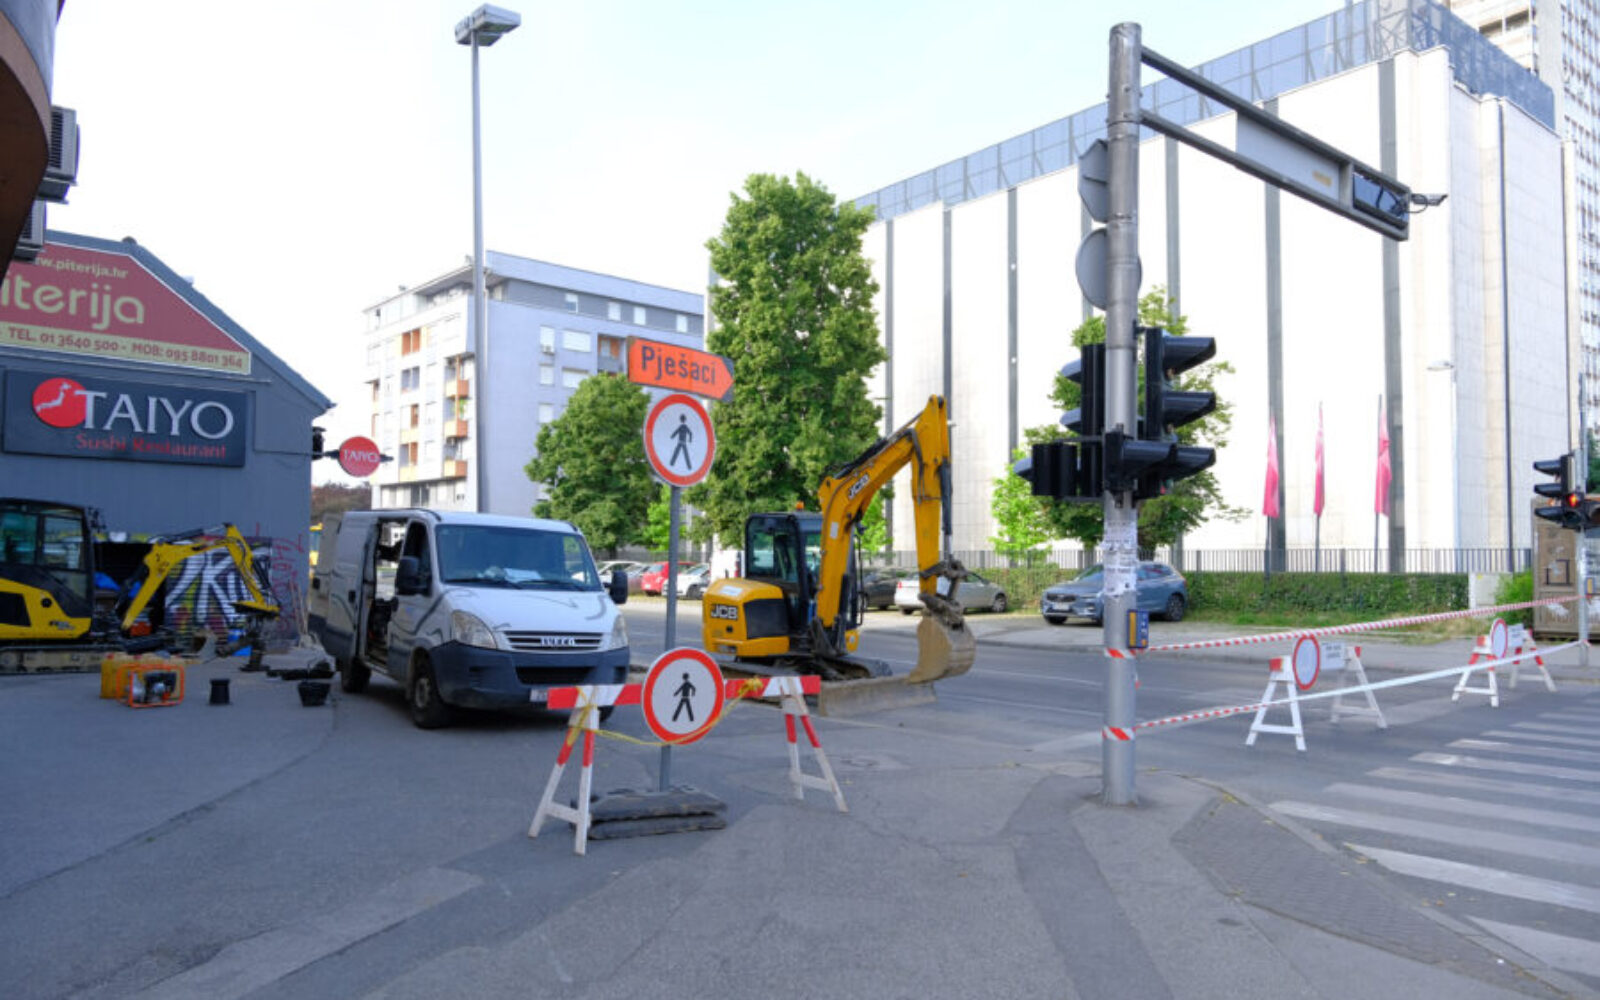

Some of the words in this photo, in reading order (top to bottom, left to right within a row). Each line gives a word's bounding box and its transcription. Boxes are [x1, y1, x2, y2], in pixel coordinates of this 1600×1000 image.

[8, 326, 36, 342] TEL.
[40, 333, 55, 344] 01
[57, 334, 91, 349] 3640
[94, 340, 119, 352] 500
[131, 342, 165, 357] MOB:
[165, 349, 188, 362] 095
[191, 350, 219, 363] 8801
[222, 355, 242, 368] 364
[641, 345, 716, 385] Pješaci
[74, 390, 234, 439] TAIYO
[76, 433, 126, 452] Sushi
[132, 437, 226, 459] Restaurant
[343, 449, 380, 463] TAIYO
[710, 604, 738, 620] JCB
[540, 635, 576, 647] IVECO
